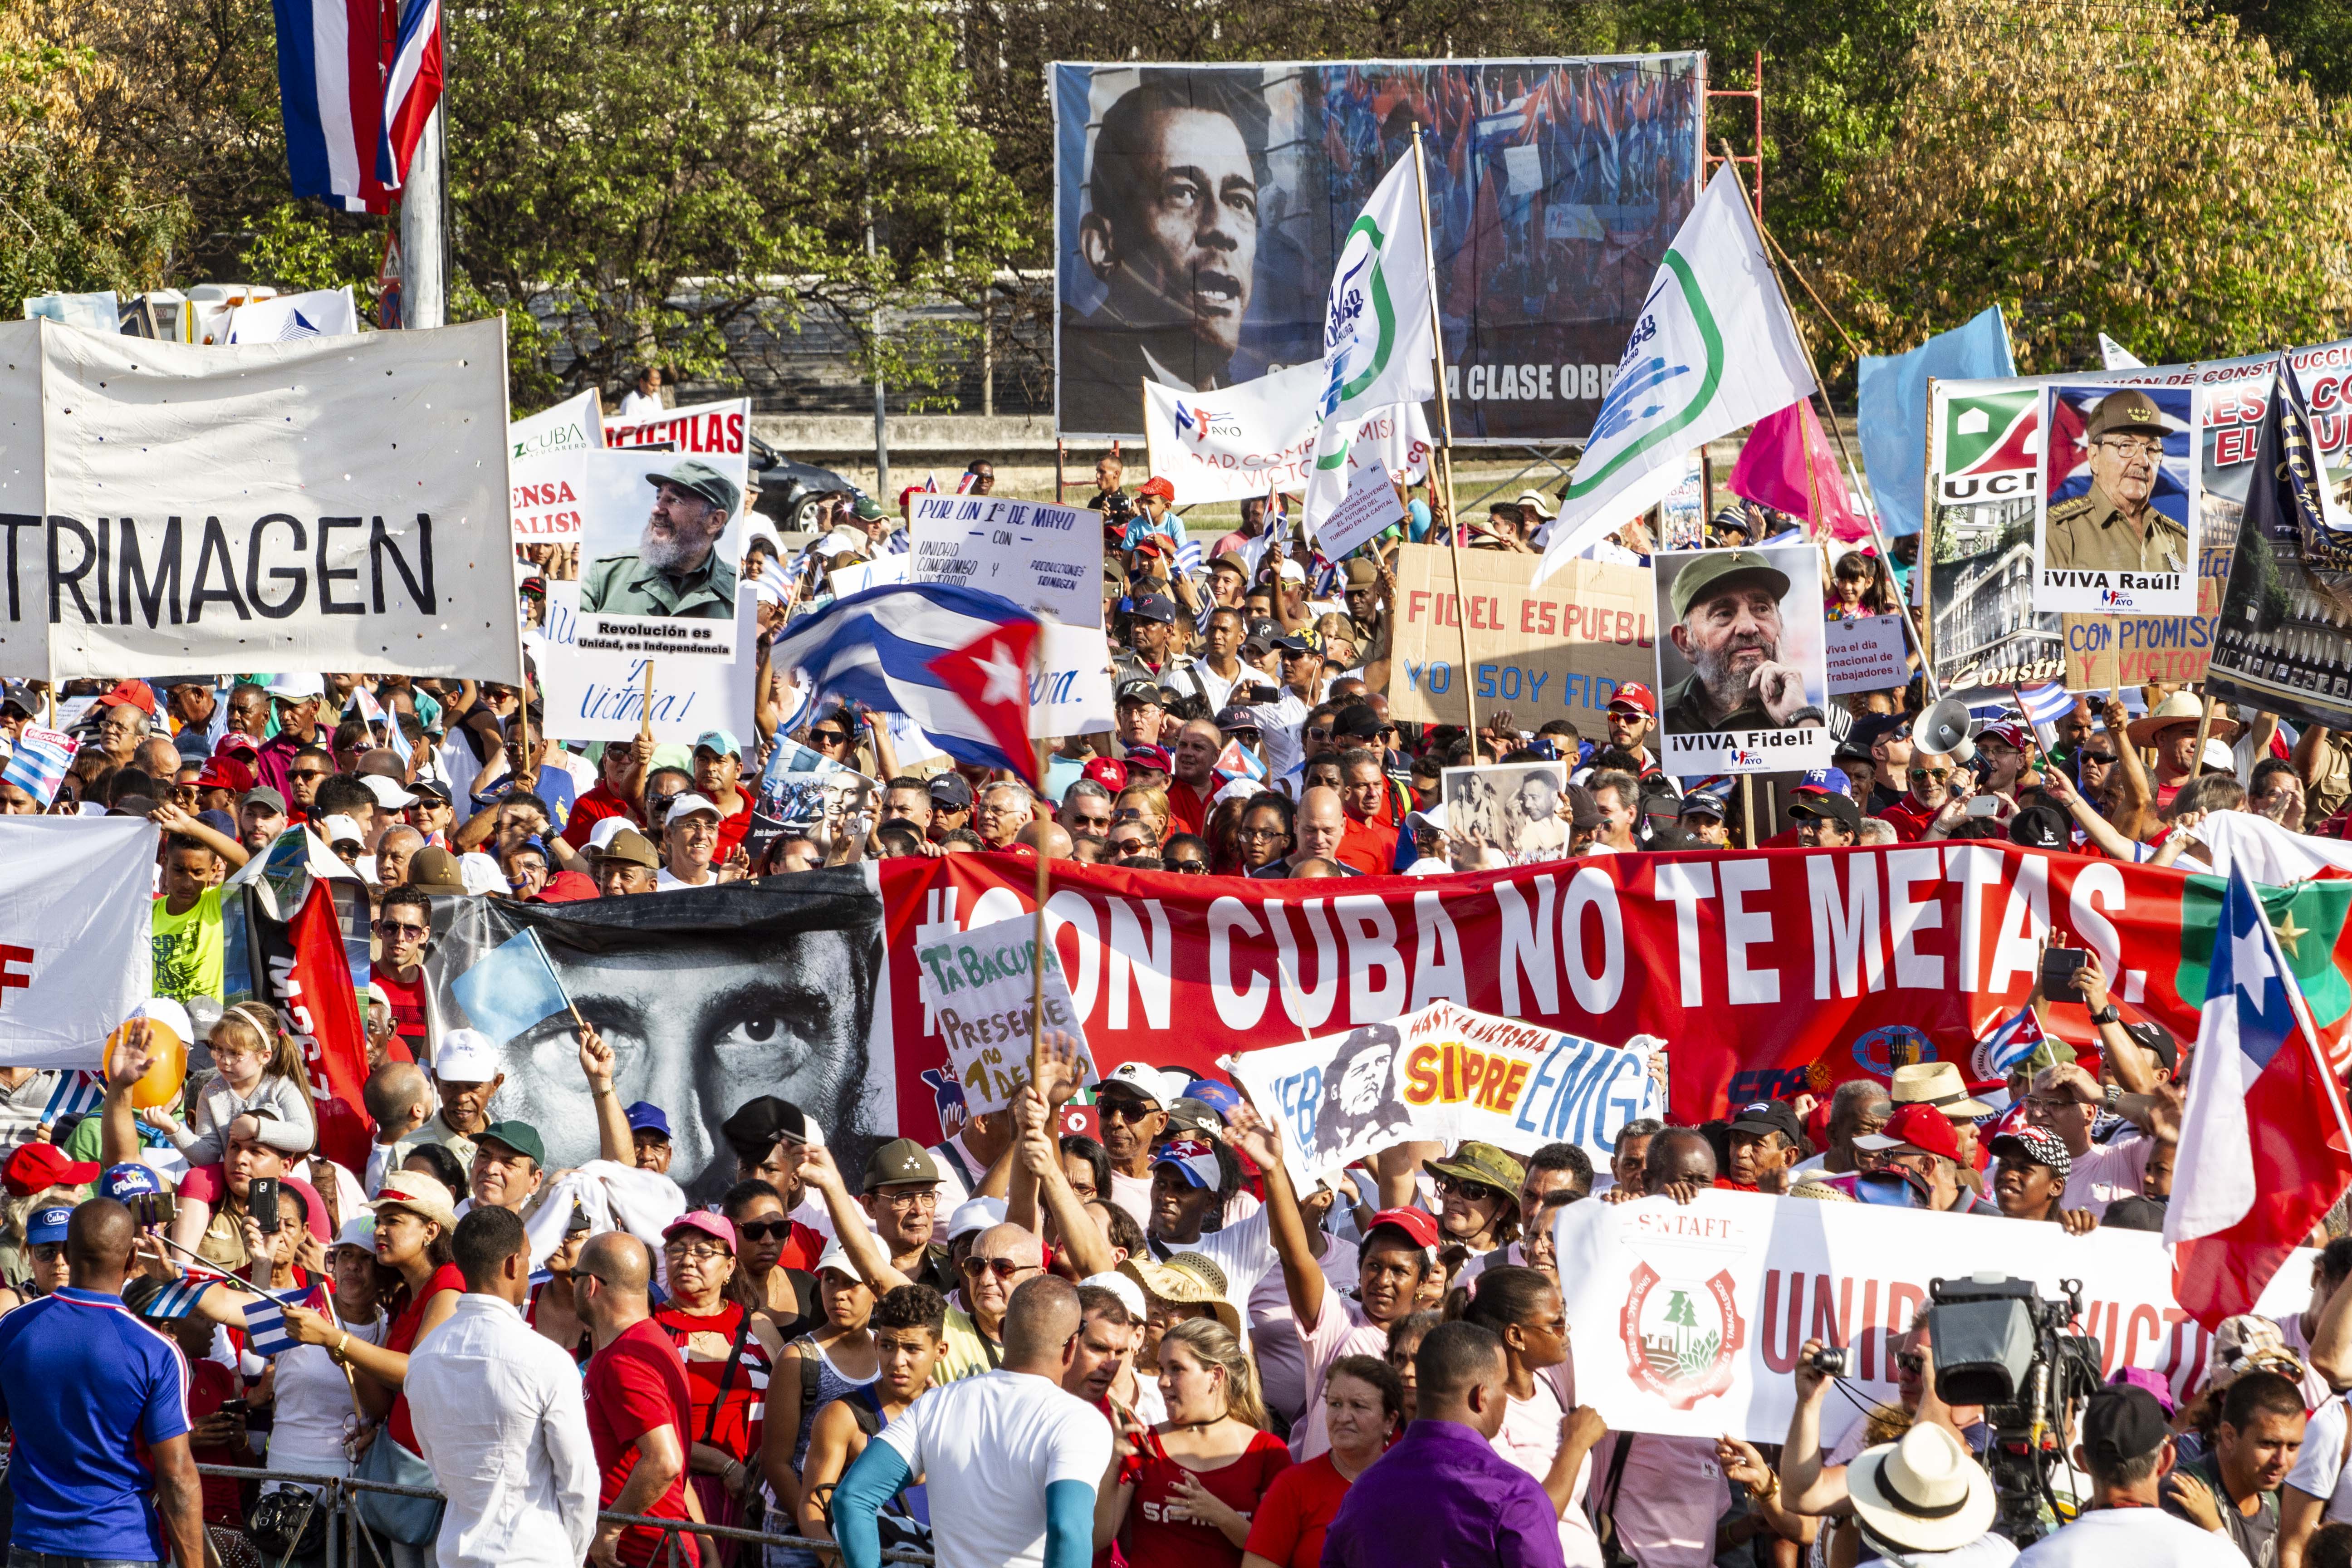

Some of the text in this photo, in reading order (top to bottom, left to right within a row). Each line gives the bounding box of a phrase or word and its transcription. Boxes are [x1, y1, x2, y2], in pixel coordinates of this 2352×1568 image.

[1468, 364, 1553, 401] CLASE
[511, 422, 584, 459] ZCUBA
[2215, 427, 2259, 466] EL
[917, 499, 953, 519] POR
[956, 501, 983, 520] UN
[1007, 505, 1029, 525] DE
[1031, 507, 1076, 531] MAYO
[1328, 499, 1394, 542] TURISMO EN LA CAPITAL
[1337, 498, 1379, 528] EL FUTURO DEL
[993, 529, 1013, 545] CON
[919, 540, 959, 557] UNIDAD
[916, 556, 978, 575] COMPROMISO
[2044, 570, 2180, 591] ¡VIVA Raúl!
[1408, 590, 1505, 631] FIDEL
[1521, 600, 1558, 634] ES
[598, 622, 711, 639] Revolución es
[578, 638, 730, 655] Unidad, es Independencia
[1826, 645, 1847, 655] Viva
[1849, 642, 1859, 652] el
[1880, 652, 1893, 662] de
[1826, 666, 1893, 682] Trabajadores
[2078, 655, 2097, 682] Y
[1403, 658, 1451, 695] YO
[1476, 664, 1549, 703] SOY
[1234, 711, 1250, 720] GAP
[1673, 730, 1813, 752] ¡VIVA Fidel!
[916, 845, 2147, 1037] #ON CUBA NO TE METAS.
[47, 1213, 65, 1222] Cuba
[1638, 1214, 1732, 1239] SNTAFT
[1634, 1274, 1651, 1295] SIND.
[1627, 1296, 1639, 1319] NAC.
[1626, 1322, 1634, 1337] DE
